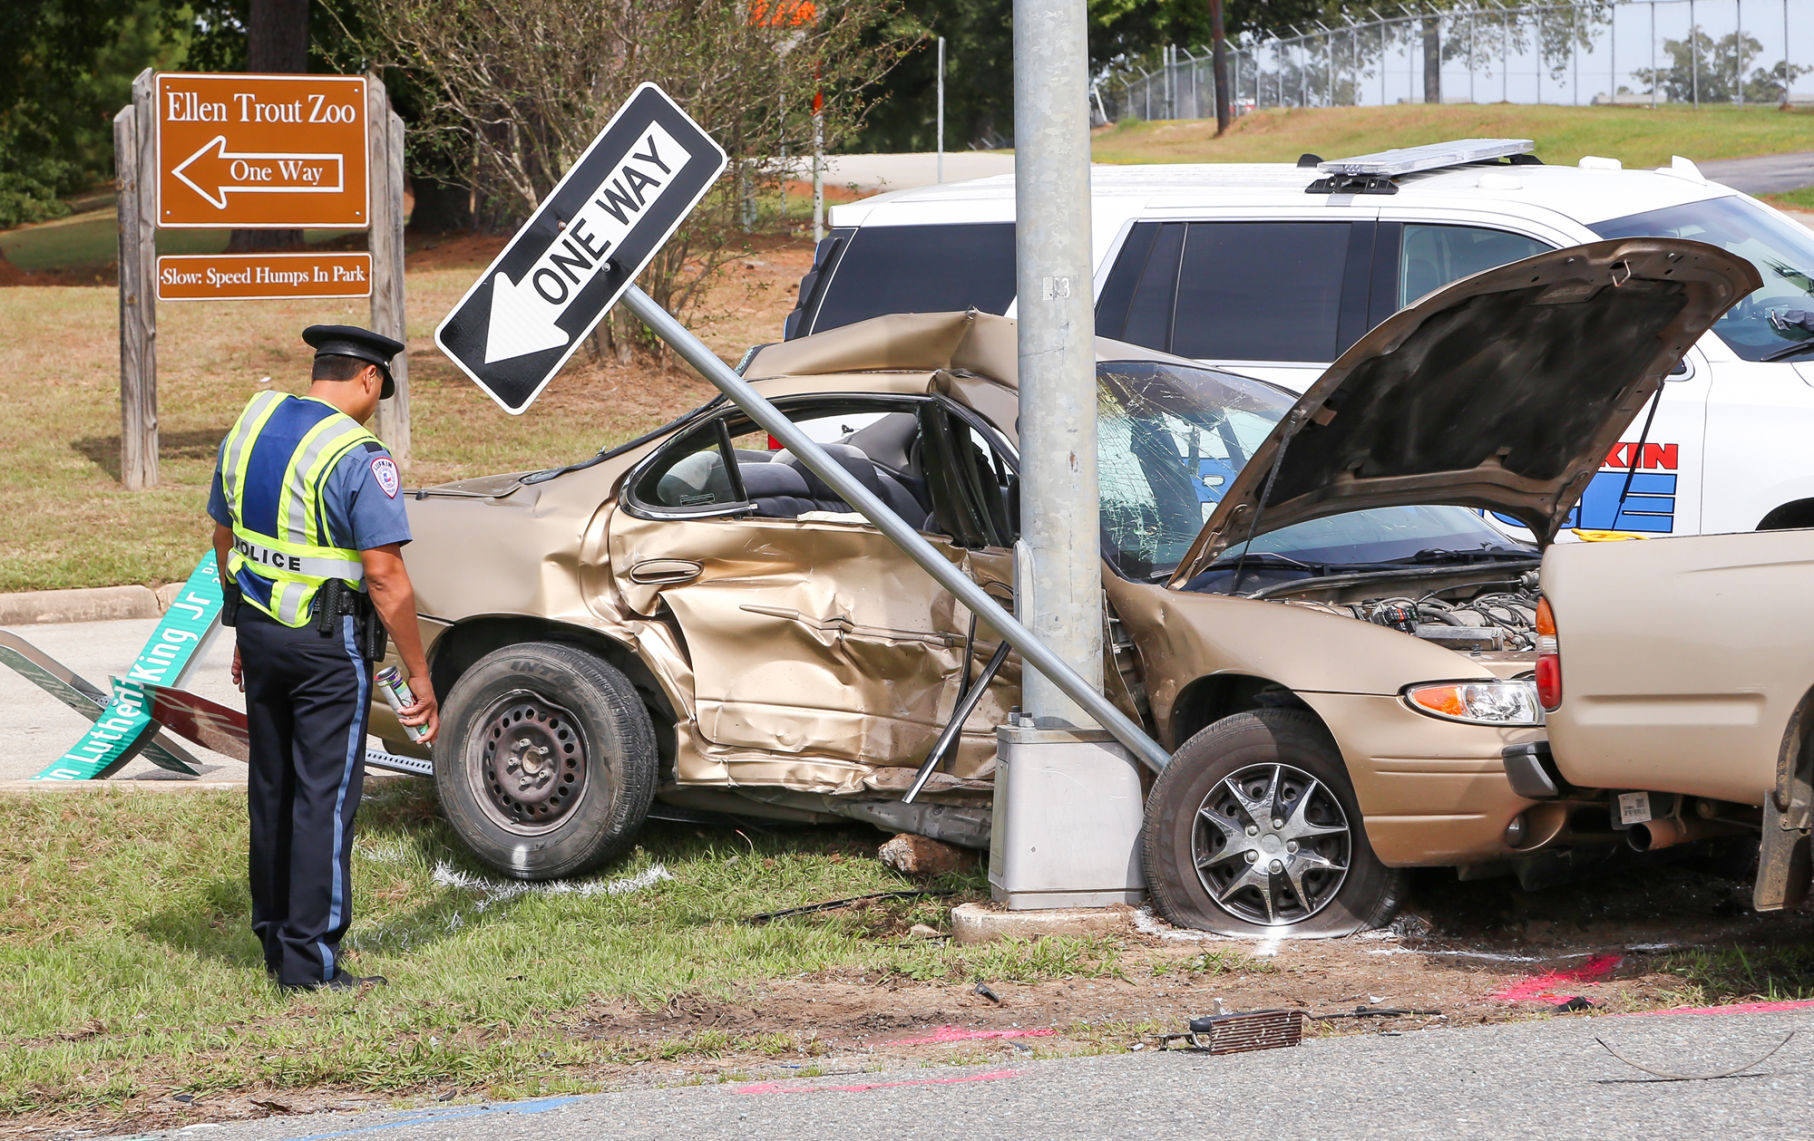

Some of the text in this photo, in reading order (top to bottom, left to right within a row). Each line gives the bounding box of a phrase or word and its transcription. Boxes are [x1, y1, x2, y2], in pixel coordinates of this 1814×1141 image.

[166, 92, 357, 124] Ellen Trout Zoo
[230, 160, 323, 186] One Way
[532, 135, 672, 306] ONE WAY
[163, 265, 366, 288] Slow: Speed Humps In Park
[1600, 442, 1679, 470] KIN
[63, 702, 142, 764] Luthe
[128, 627, 199, 682] King
[173, 591, 211, 620] Jr
